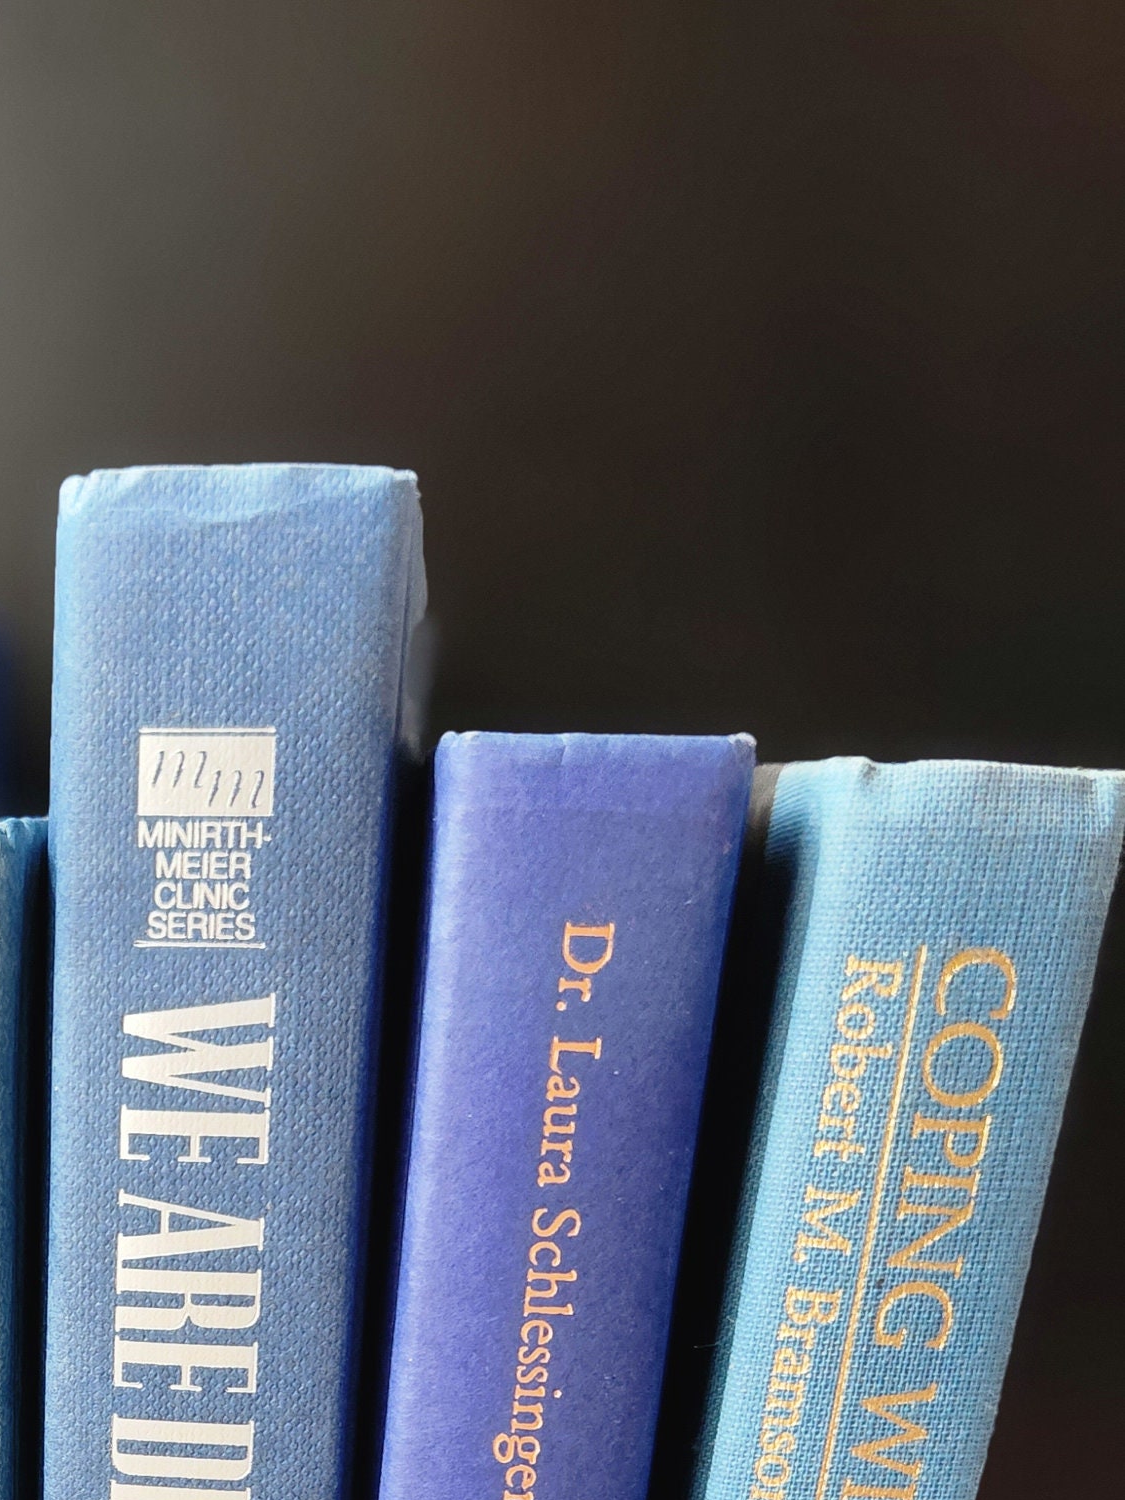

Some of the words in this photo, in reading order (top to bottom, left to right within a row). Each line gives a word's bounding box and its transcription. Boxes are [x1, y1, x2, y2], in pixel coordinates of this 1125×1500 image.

[136, 820, 272, 850] MINIRTH-
[155, 850, 252, 880] MEIER
[146, 911, 256, 940] SERIES
[153, 881, 251, 911] CLINIC
[557, 921, 616, 1011] Dr.
[119, 991, 276, 1166] WE
[814, 954, 904, 1163] Robert
[537, 1036, 602, 1188] Laura
[875, 947, 1018, 1353] COPING
[794, 1184, 863, 1263] M.
[112, 1188, 265, 1393] ARE
